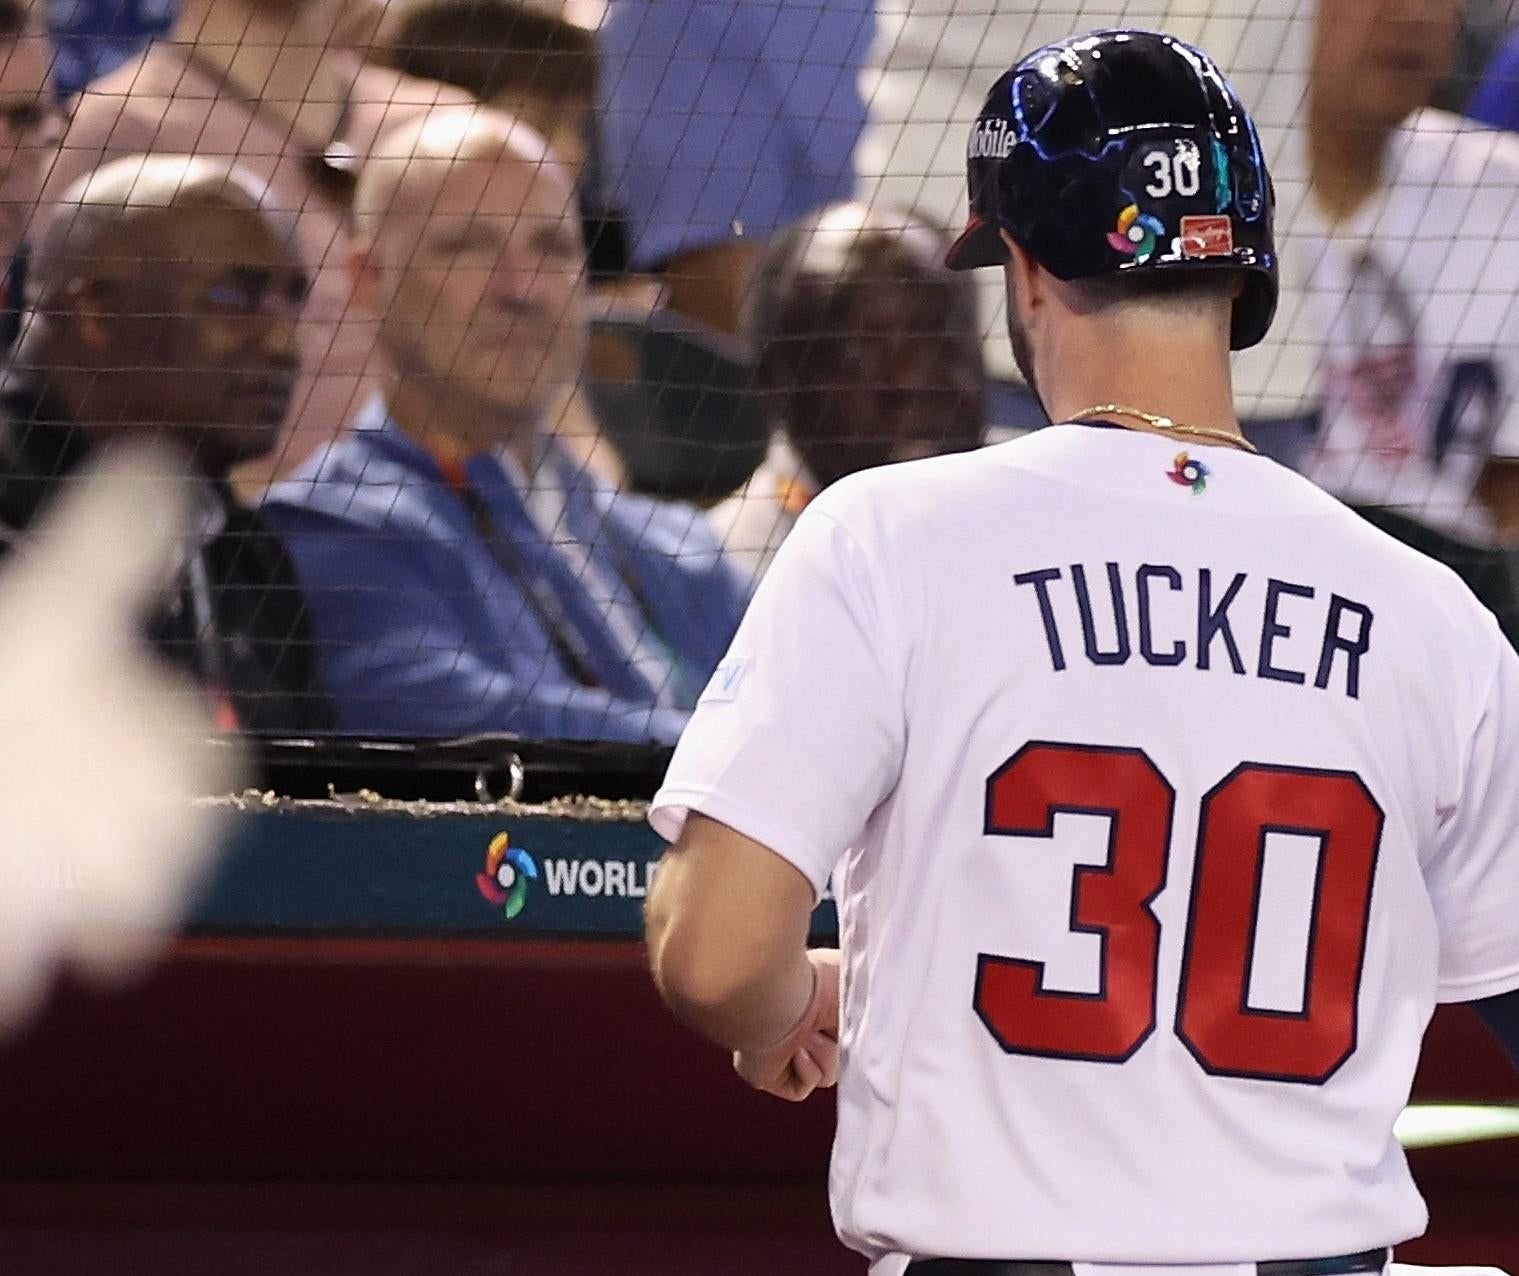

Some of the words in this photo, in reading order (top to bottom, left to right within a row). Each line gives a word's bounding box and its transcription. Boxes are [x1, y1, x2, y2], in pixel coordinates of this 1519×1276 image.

[1143, 149, 1200, 197] 30
[1013, 562, 1373, 699] TUCKER
[973, 740, 1385, 1086] 30
